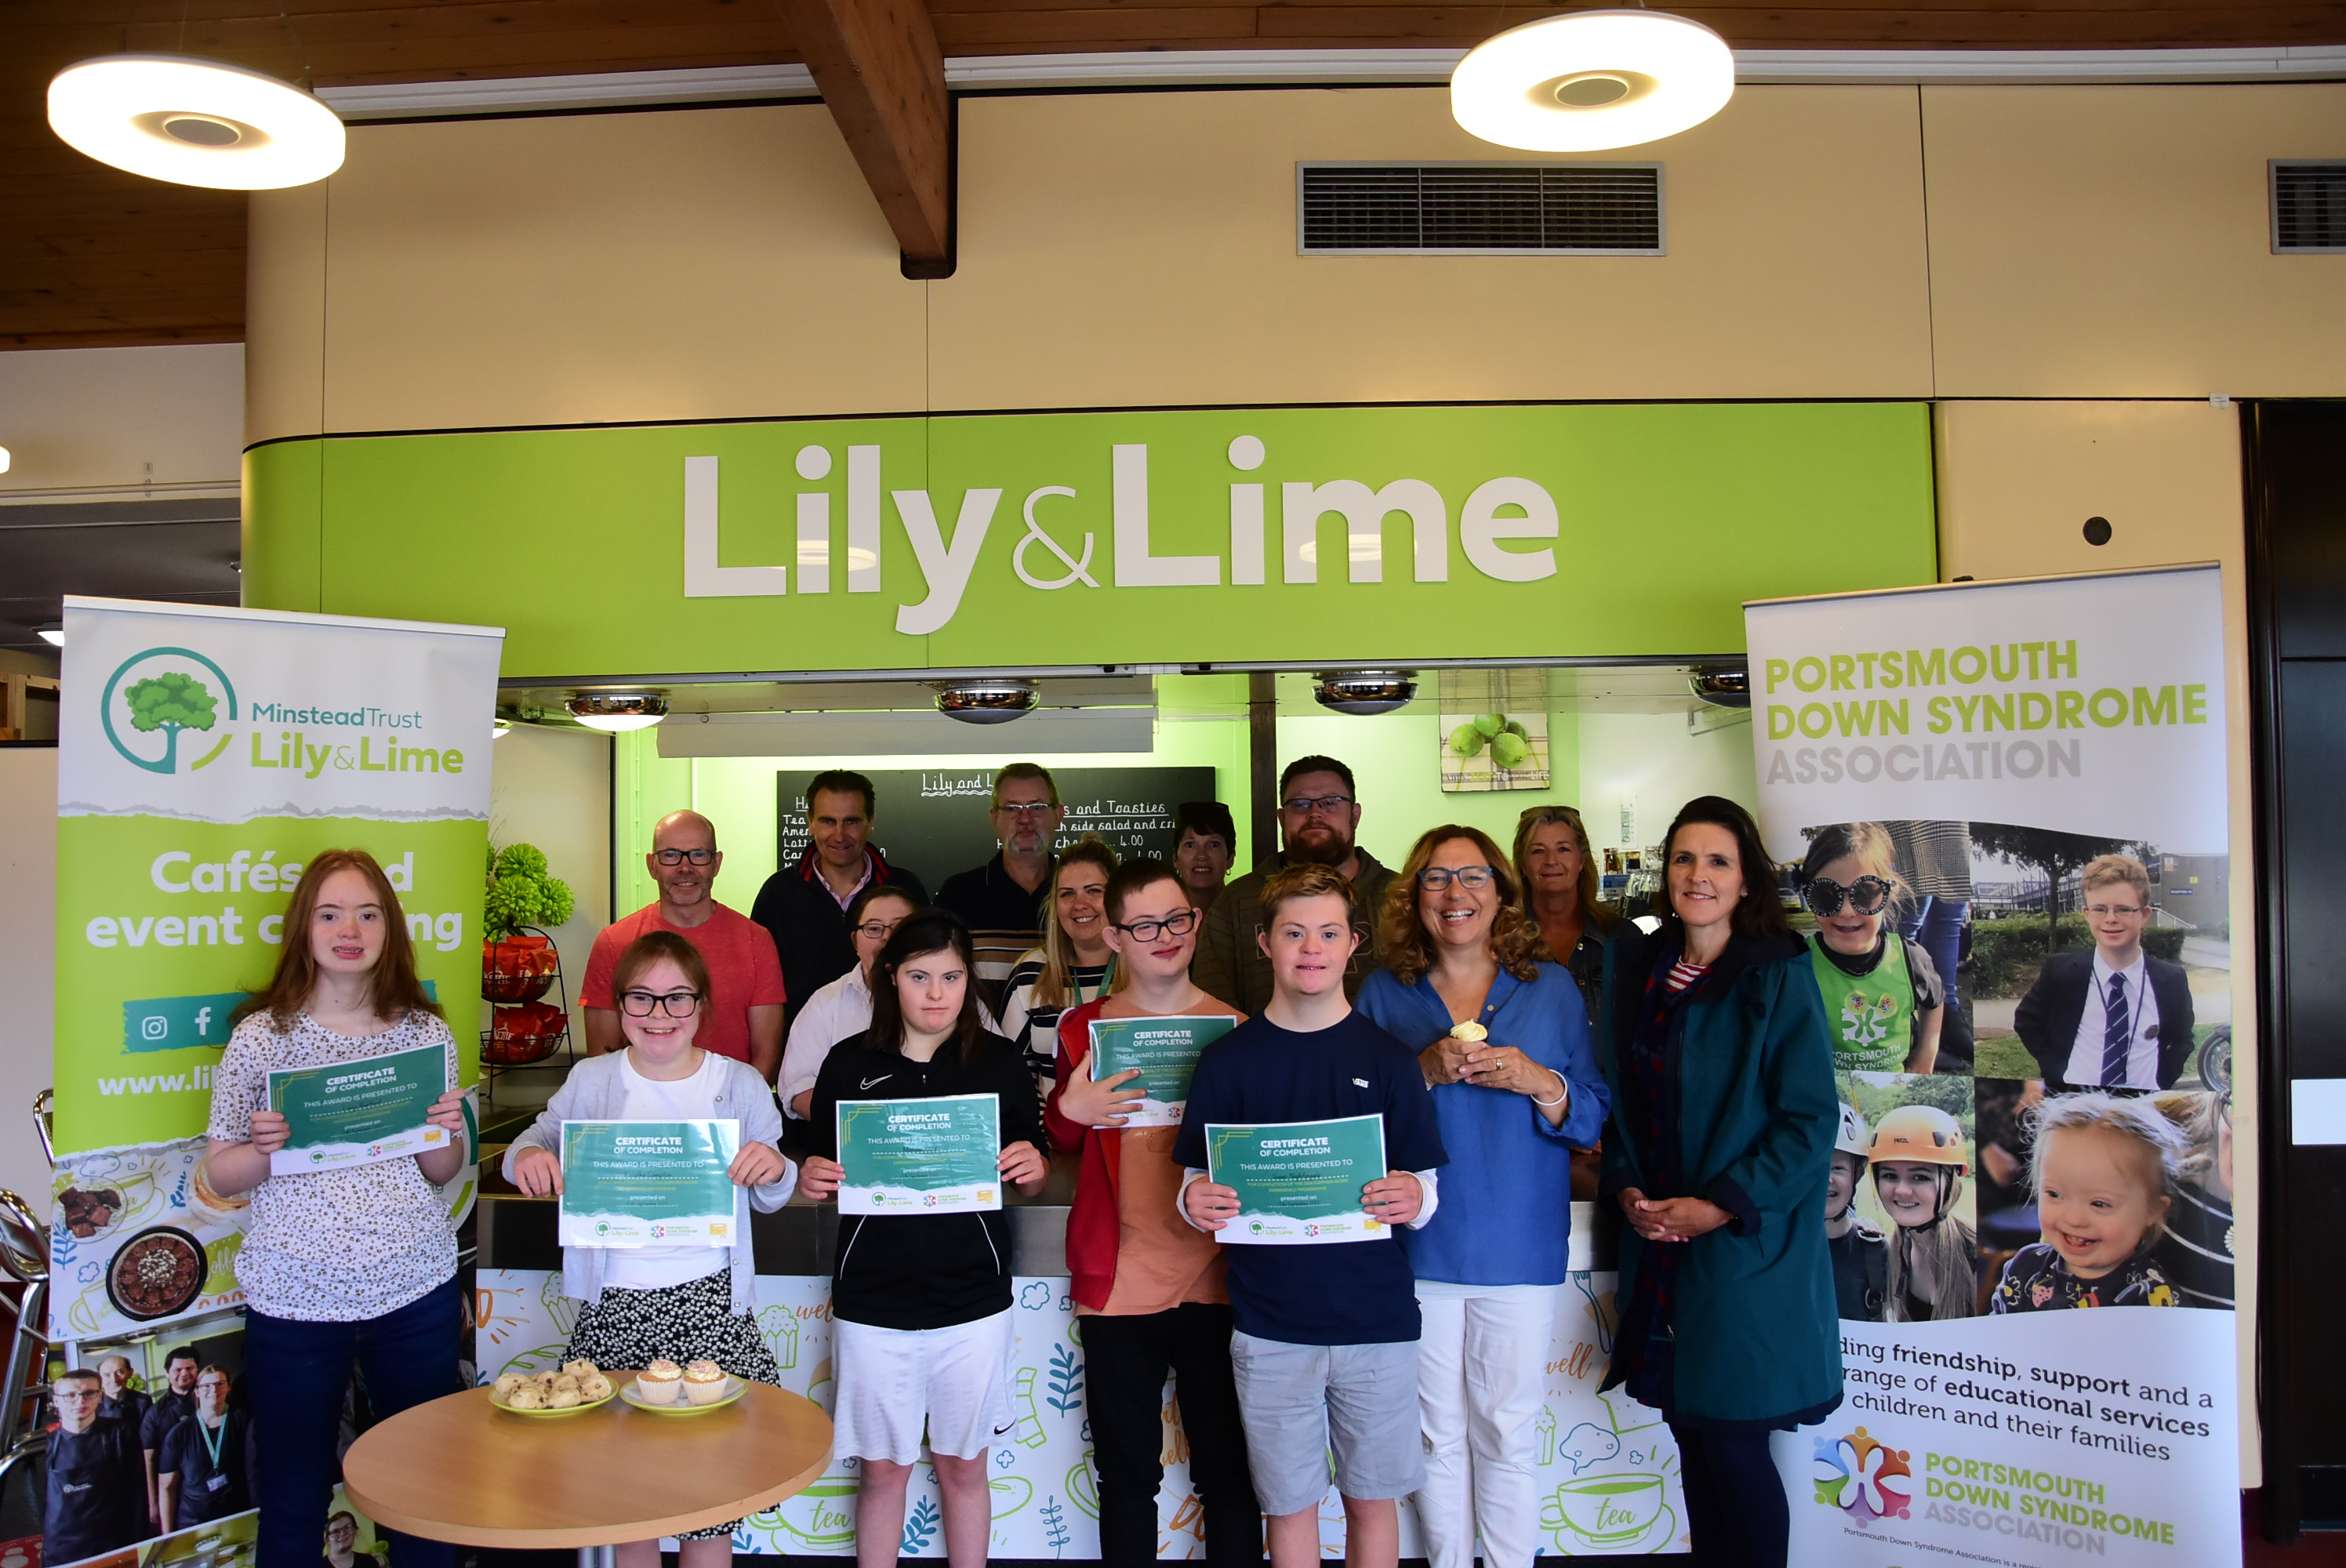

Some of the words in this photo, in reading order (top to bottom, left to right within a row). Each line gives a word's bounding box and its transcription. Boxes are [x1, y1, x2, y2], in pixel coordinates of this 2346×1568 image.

[1766, 640, 2078, 695] PORTSMOUTH
[1767, 699, 1908, 740] DOWN
[1927, 684, 2207, 735] SYNDROME
[1767, 739, 2081, 785] ASSOCIATION
[923, 772, 953, 797] Lily
[957, 775, 982, 789] and
[783, 815, 806, 824] Tea
[1077, 800, 1101, 815] and
[1106, 800, 1166, 814] Toasties
[1070, 821, 1095, 831] side
[1098, 818, 1131, 830] salad
[1133, 818, 1157, 829] and
[1159, 818, 1176, 829] cri
[784, 838, 812, 848] Latt
[1120, 835, 1143, 847] 4.00
[151, 850, 303, 893] Cafés
[85, 906, 244, 948] event
[1134, 1030, 1191, 1040] CERTIFICATE
[1832, 1043, 1901, 1061] ORTSMOUTH
[98, 1065, 220, 1096] www.lil
[325, 1084, 338, 1094] OF
[340, 1075, 397, 1092] COMPLETION
[326, 1067, 395, 1086] CERTIFICATE
[303, 1100, 321, 1109] THIS
[322, 1096, 351, 1107] AWARD
[361, 1085, 405, 1100] PRESENTED
[888, 1113, 950, 1123] CERTIFICATE
[899, 1122, 951, 1131] COMPLETION
[616, 1137, 682, 1145] CERTIFICATE
[1260, 1137, 1328, 1149] CERTIFICATE
[1273, 1147, 1331, 1156] COMPLETION
[1295, 1160, 1341, 1170] PRESENTED
[795, 1294, 833, 1323] wel
[1893, 1344, 2021, 1381] friendship,
[2030, 1366, 2130, 1397] support
[2139, 1386, 2189, 1406] and
[2198, 1392, 2213, 1408] a
[1843, 1367, 1906, 1391] range
[1914, 1375, 1937, 1392] of
[1945, 1380, 2092, 1418] educational
[2100, 1406, 2210, 1437] services
[1852, 1392, 1946, 1421] children
[1953, 1410, 1999, 1429] and
[2006, 1414, 2063, 1440] their
[2070, 1425, 2170, 1461] families
[1926, 1452, 2104, 1504] PORTSMOUTH
[809, 1500, 852, 1533] tea
[1594, 1497, 1636, 1530] tea
[1926, 1477, 2010, 1510] DOWN
[2020, 1494, 2174, 1545] SYNDROME
[1923, 1501, 2104, 1556] ASSOCIATION
[1843, 1526, 1888, 1542] Portsmouth
[1889, 1536, 1912, 1548] Down
[1914, 1541, 1954, 1555] Syndrome
[1955, 1549, 2001, 1565] Association
